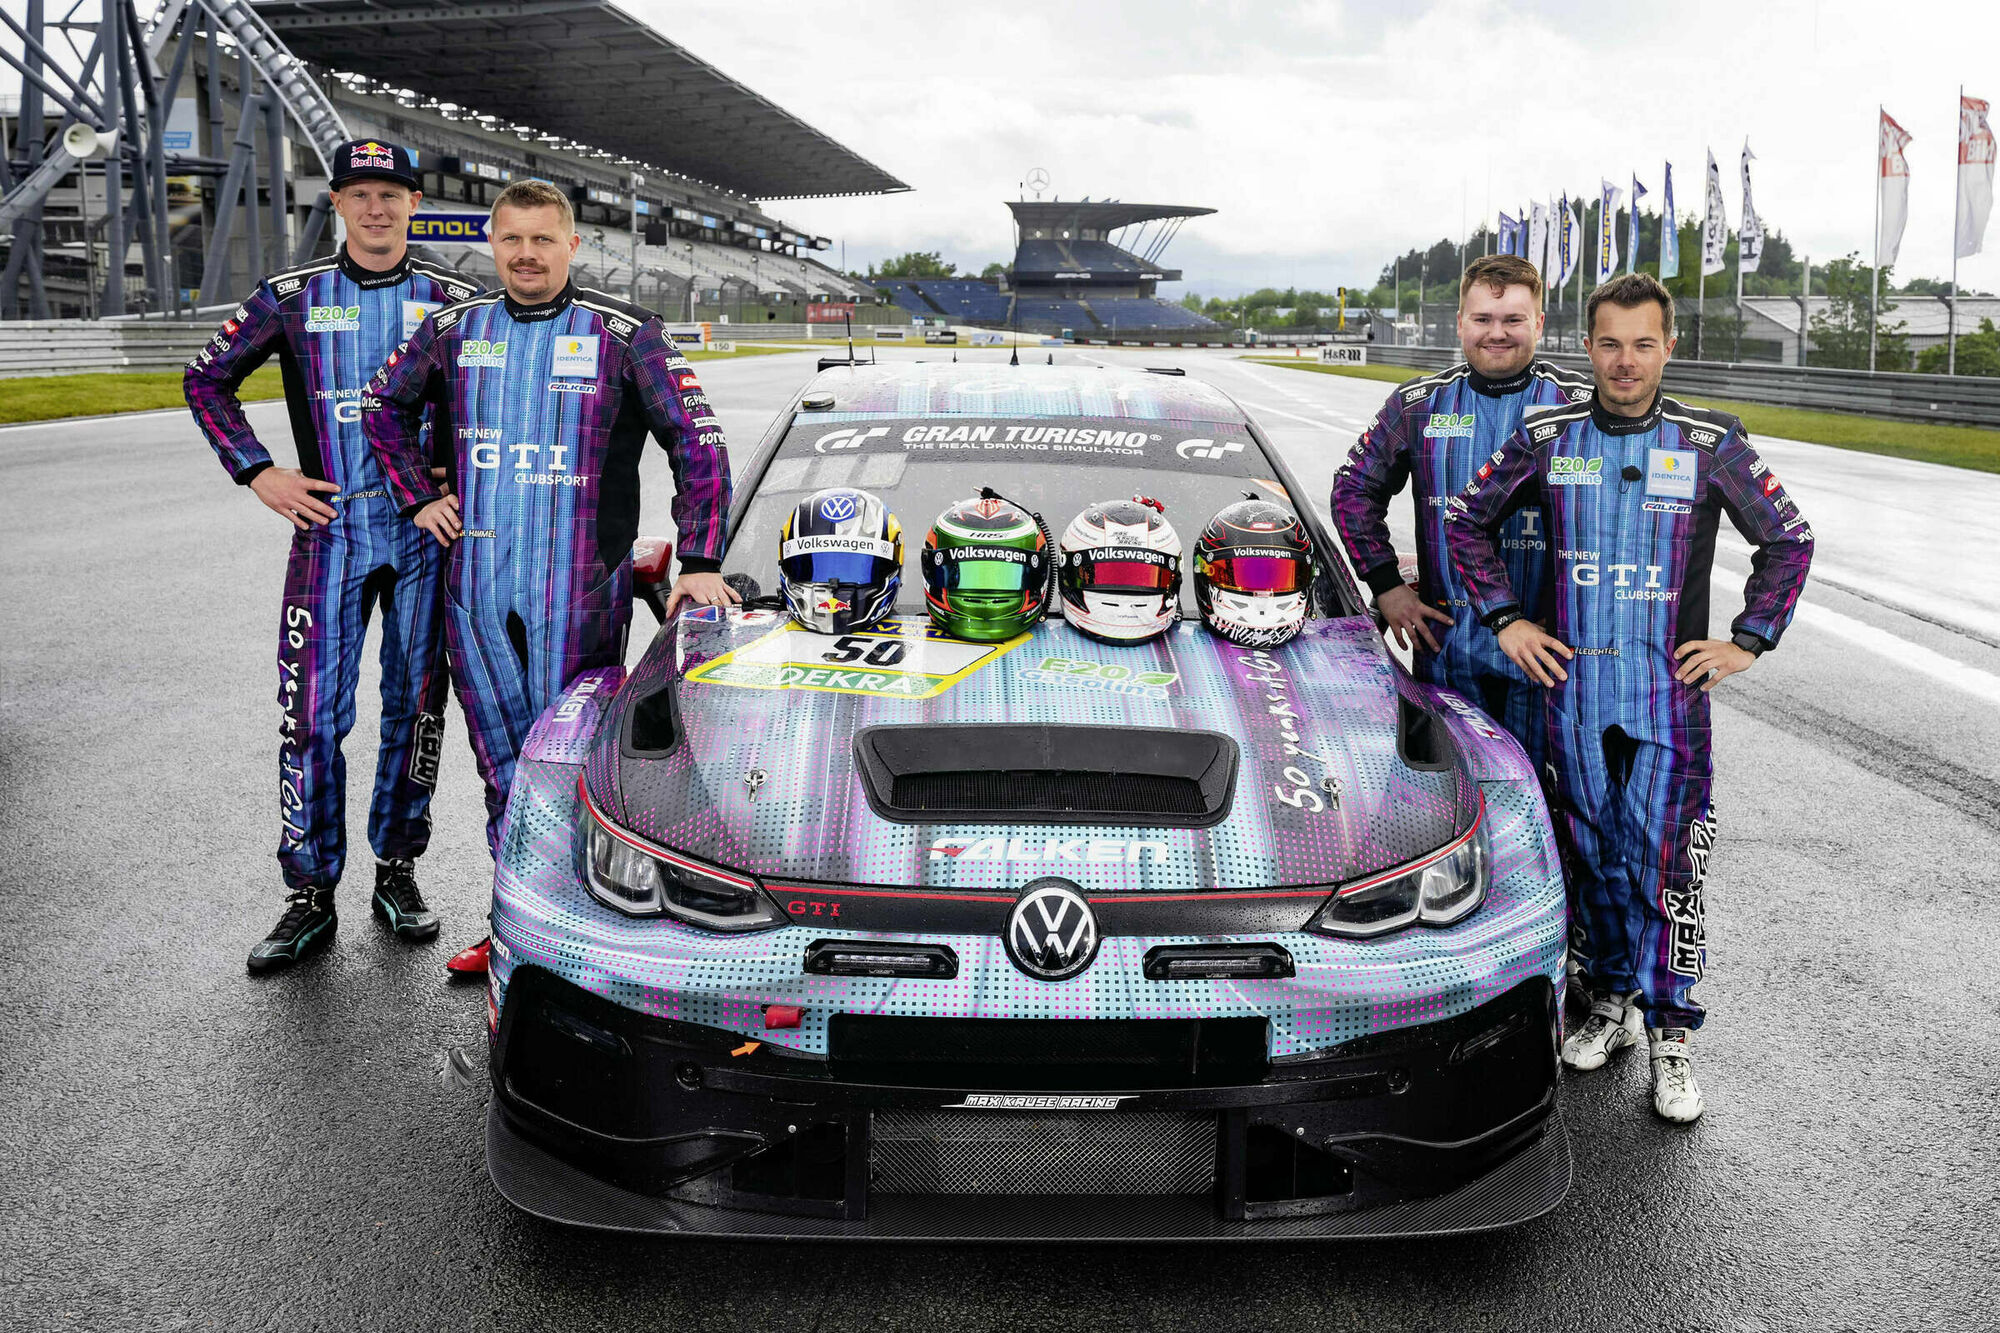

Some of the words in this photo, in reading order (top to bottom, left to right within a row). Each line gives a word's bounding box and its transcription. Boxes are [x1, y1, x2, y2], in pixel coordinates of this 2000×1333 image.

[351, 157, 372, 168] Red
[373, 157, 394, 169] Bull
[408, 220, 479, 236] ENOL
[277, 281, 301, 292] OMP
[361, 273, 402, 287] Volkswagen
[447, 285, 470, 299] OMP
[310, 307, 342, 321] E20
[513, 307, 558, 317] Volkswagen
[305, 319, 360, 332] Gasoline
[437, 312, 457, 327] OMP
[608, 319, 632, 335] OMP
[462, 341, 490, 355] E20
[714, 343, 729, 351] 150
[457, 354, 505, 367] Gasoline
[1323, 349, 1346, 360] H&R
[550, 384, 595, 392] FALKEN
[1487, 377, 1526, 389] Volkswagen
[316, 390, 334, 400] THE
[336, 389, 362, 399] NEW
[1405, 388, 1427, 400] OMP
[1429, 414, 1459, 427] E20
[1608, 416, 1654, 429] Volkswagen
[458, 428, 473, 439] THE
[475, 428, 503, 439] NEW
[902, 426, 997, 442] GRAN
[1423, 425, 1473, 437] Gasoline
[1534, 427, 1557, 440] OMP
[1689, 430, 1717, 445] OMP
[470, 443, 568, 470] GTI
[1053, 445, 1144, 456] SIMULATOR
[1551, 457, 1584, 472] E20
[515, 472, 589, 487] CLUBSPORT
[1547, 471, 1601, 485] Gasoline
[1651, 473, 1691, 482] IDENTICA
[1428, 496, 1442, 507] THE
[1644, 503, 1691, 512] FALKEN
[469, 530, 497, 538] HAMMEL
[797, 537, 874, 551] Volkswagen
[1502, 539, 1547, 551] UBSPO
[950, 547, 1027, 563] Volkswagen
[1088, 548, 1165, 565] Volkswagen
[1233, 548, 1291, 559] Volkswagen
[1558, 550, 1573, 560] THE
[1574, 551, 1600, 561] NEW
[1572, 563, 1662, 588] GTI
[1614, 589, 1678, 602] CLUBSPORT
[287, 605, 312, 649] 50
[821, 636, 907, 667] 50
[1578, 646, 1619, 656] LEUCHTER
[1040, 657, 1130, 680] E20
[772, 667, 913, 694] DEKRA
[1017, 668, 1169, 699] Gasoline
[552, 677, 604, 723] FALKEN
[1437, 692, 1502, 740] FALKEN
[1275, 766, 1324, 813] 50
[924, 837, 1169, 864] FALKEN
[787, 900, 841, 917] GTI
[1670, 893, 1698, 970] MAX
[965, 1096, 1001, 1107] MAX
[1059, 1097, 1118, 1108] RACING
